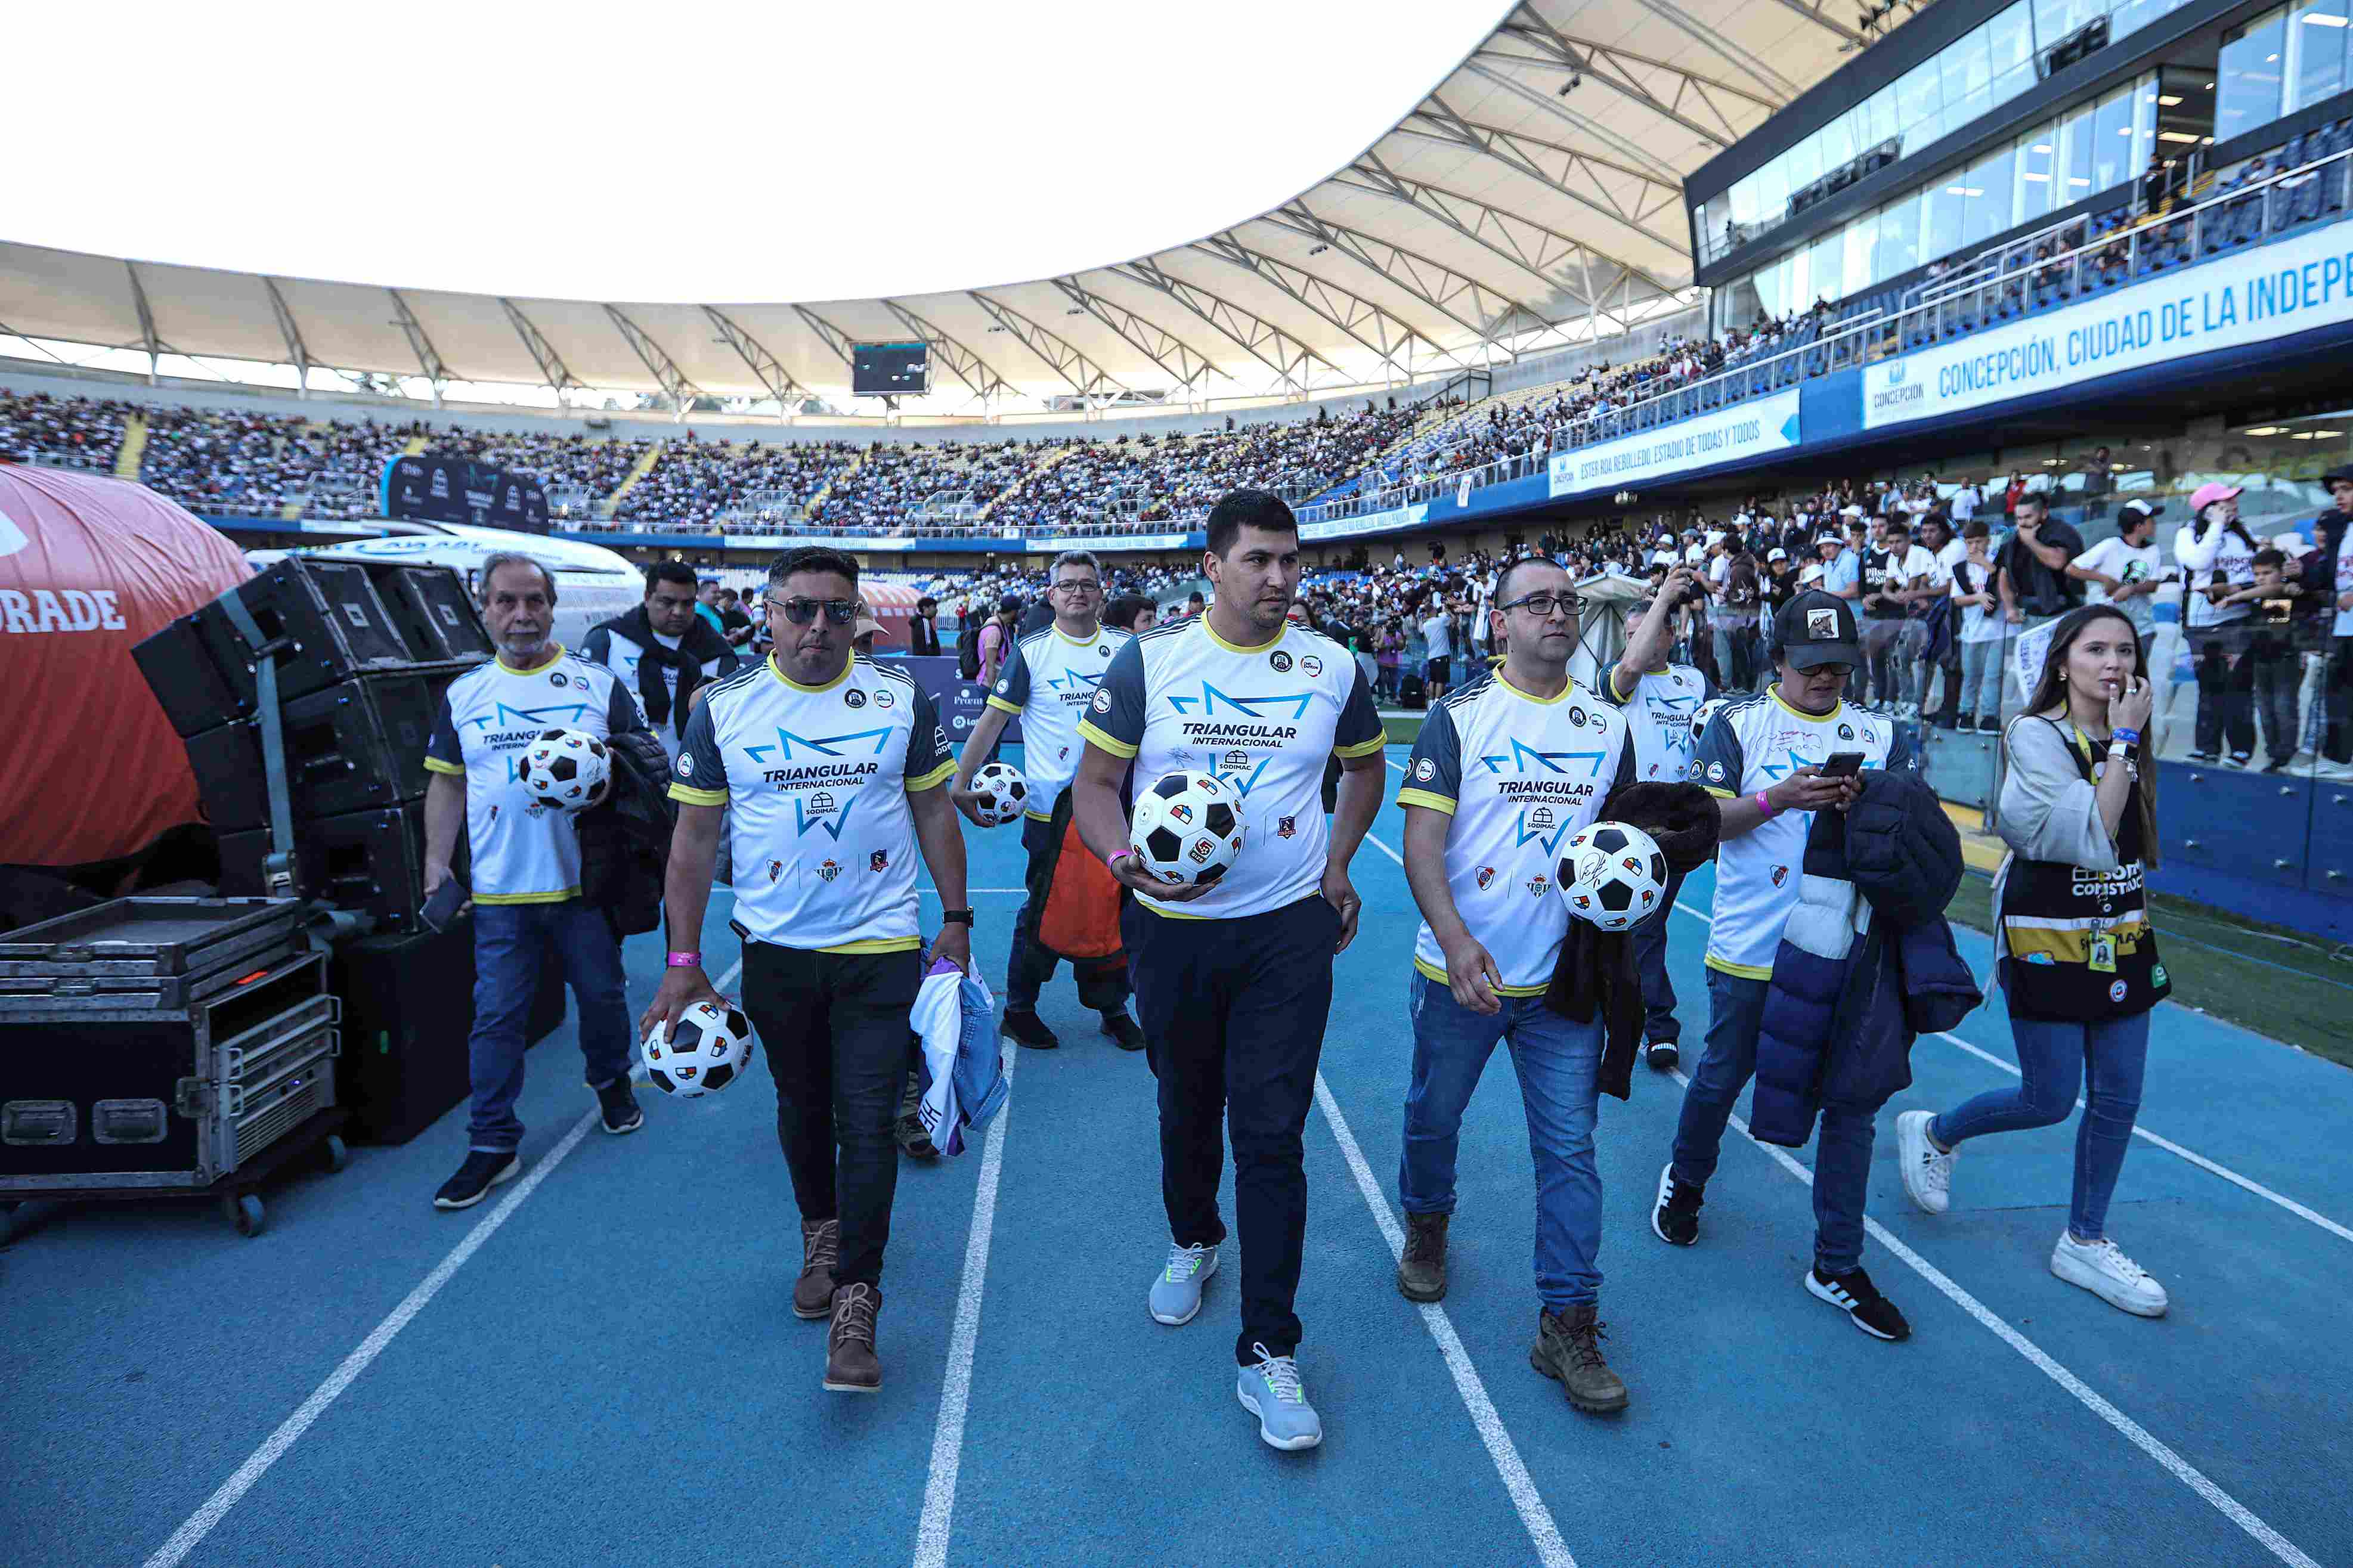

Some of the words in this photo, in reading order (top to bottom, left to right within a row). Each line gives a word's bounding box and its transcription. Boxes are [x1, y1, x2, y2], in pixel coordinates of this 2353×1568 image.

[2069, 309, 2152, 367] CIUDAD
[2162, 298, 2194, 342] DE
[2205, 286, 2237, 332] LA
[1581, 457, 1599, 479] ESTER
[1654, 439, 1684, 466] ESTADIO
[1686, 436, 1696, 457] DE
[1698, 429, 1723, 453] TODAS
[1732, 419, 1761, 445] TODOS
[0, 589, 126, 633] RADE
[483, 730, 540, 744] TRIANG
[1182, 723, 1297, 739] TRIANGULAR
[1192, 737, 1283, 748] INTERNACIONAL
[763, 763, 878, 783] TRIANGULAR
[778, 777, 865, 791] INTERNACIONAL
[1499, 781, 1593, 797] TRIANGULAR
[1508, 795, 1582, 805] INTERNACIONAL
